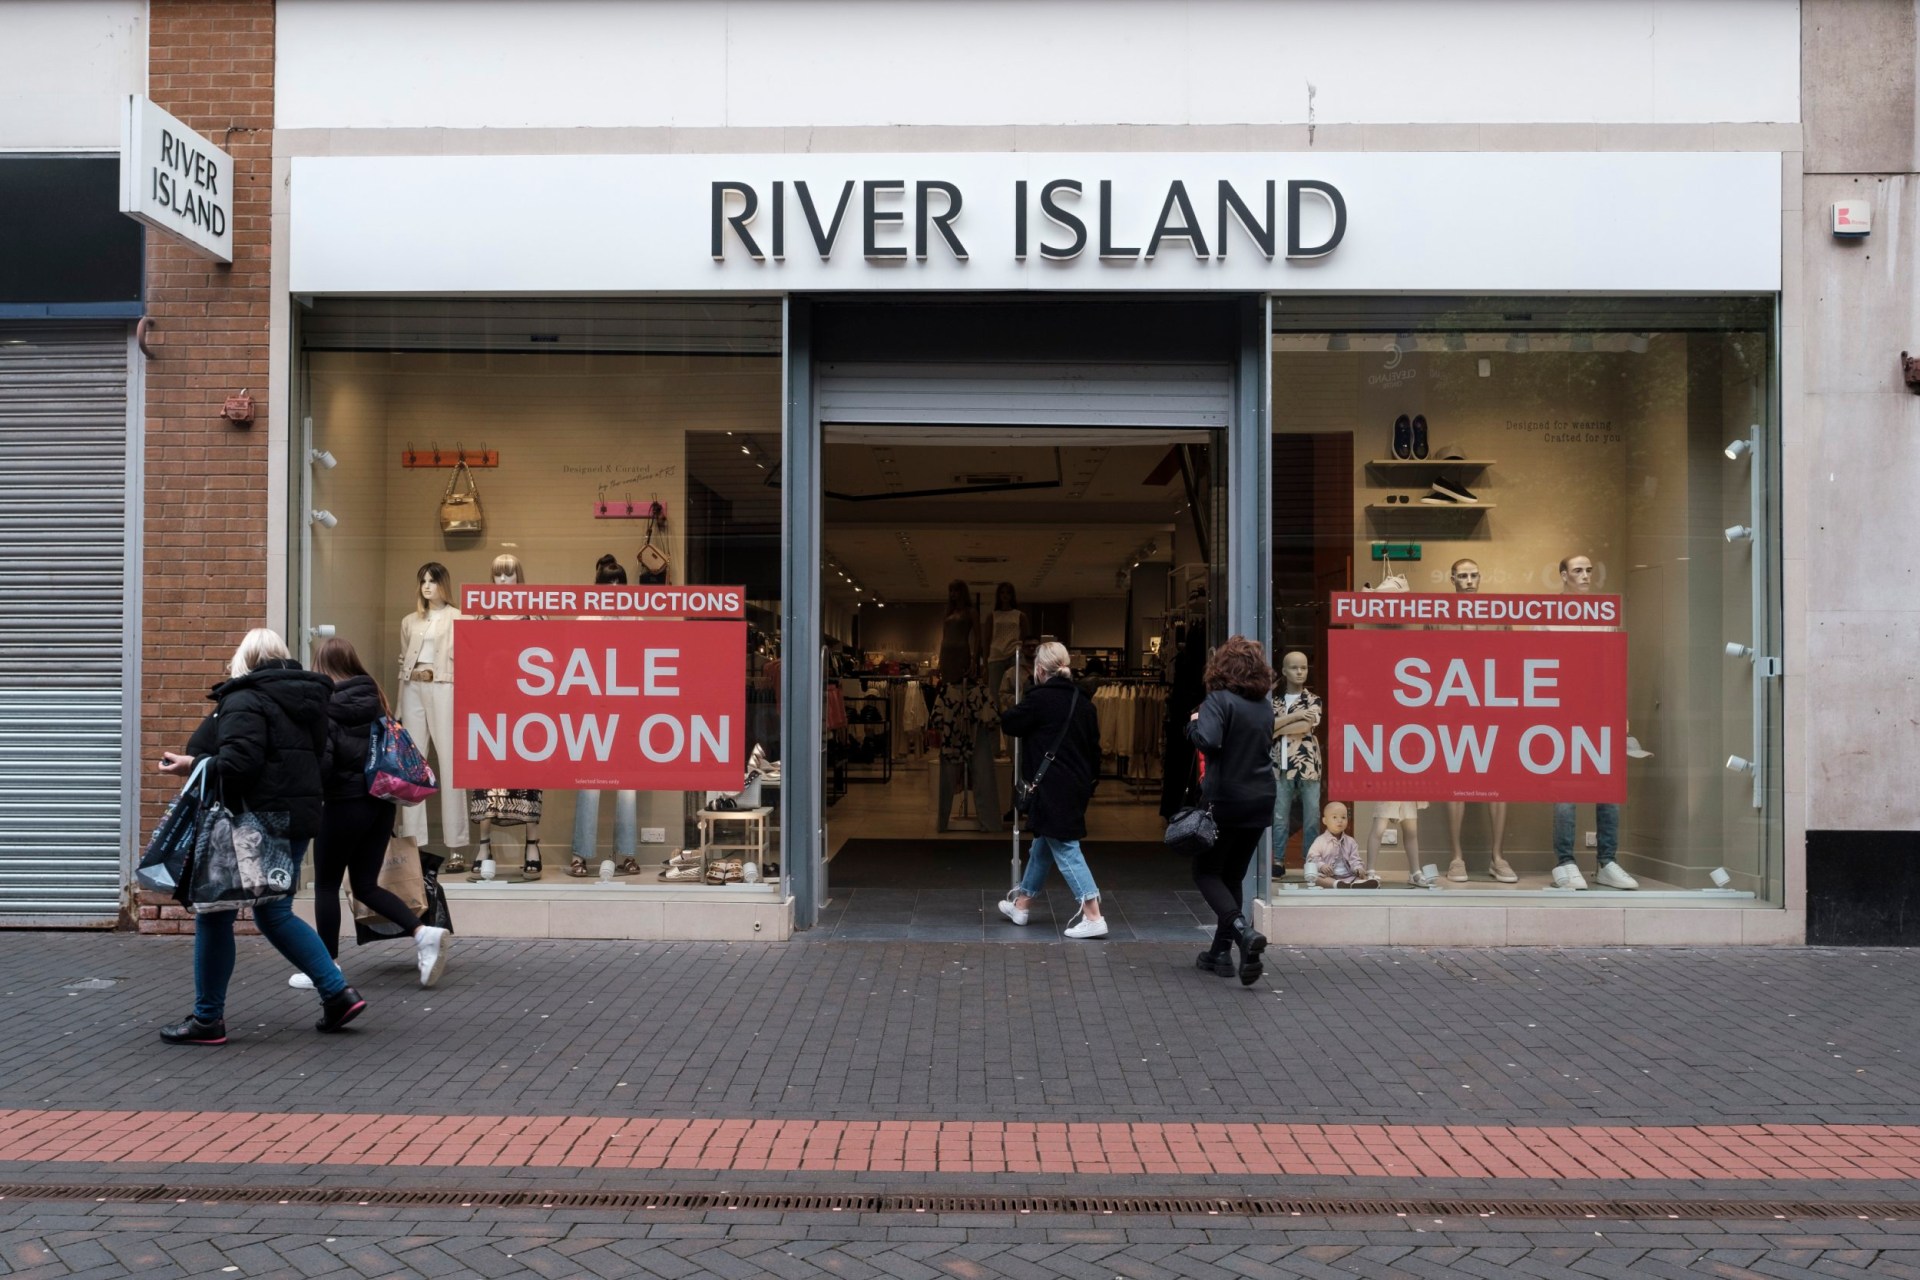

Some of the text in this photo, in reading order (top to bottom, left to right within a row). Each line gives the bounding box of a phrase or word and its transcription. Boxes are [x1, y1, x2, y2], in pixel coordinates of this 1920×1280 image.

[161, 129, 217, 195] RIVER
[152, 167, 225, 237] ISLAND
[711, 179, 1348, 260] RIVER ISLAND
[1506, 420, 1549, 431] Designed
[1554, 420, 1568, 430] for
[1544, 433, 1621, 444] Crafted for you
[563, 464, 650, 474] Designed & Curated
[467, 591, 739, 612] FURTHER REDUCTIONS
[1337, 598, 1616, 621] FURTHER REDUCTIONS
[516, 647, 680, 697] SALE
[1393, 657, 1560, 708] SALE
[468, 712, 730, 763] NOW ON
[1343, 724, 1611, 775] NOW ON
